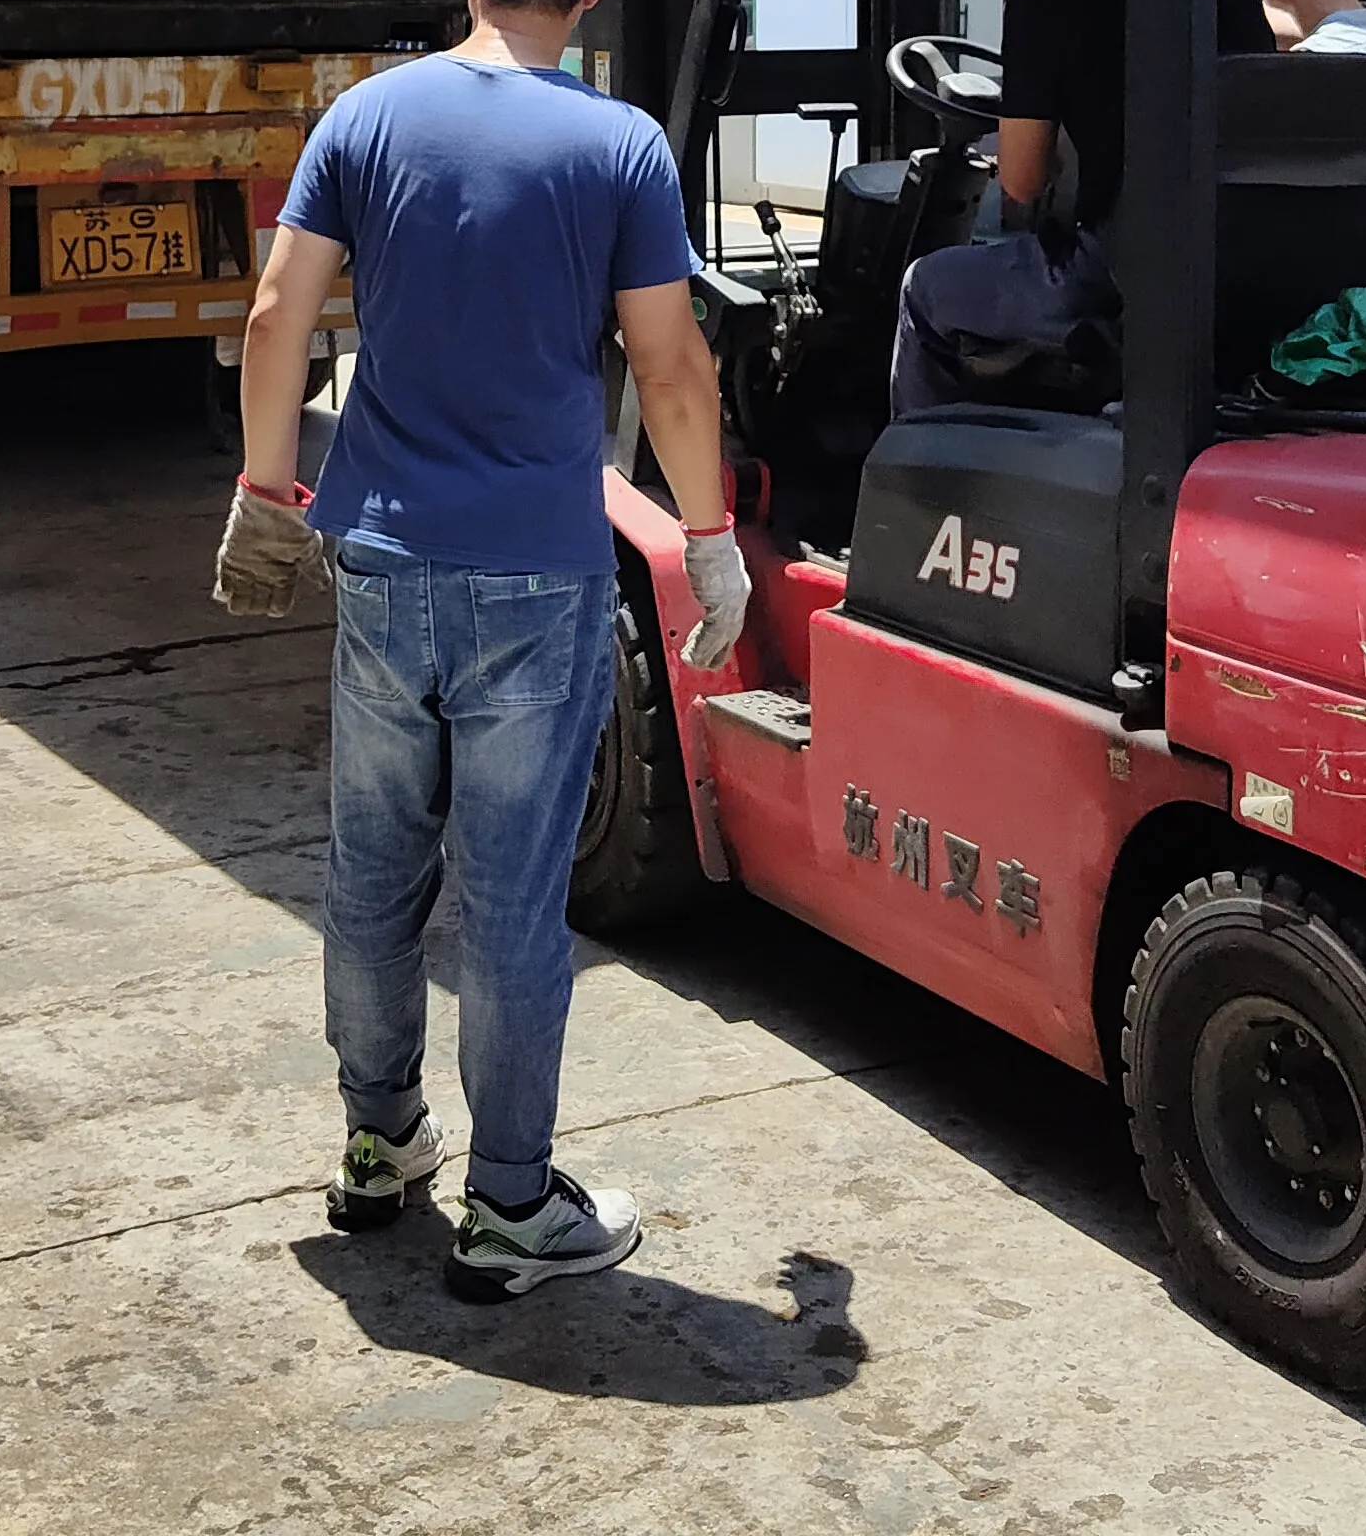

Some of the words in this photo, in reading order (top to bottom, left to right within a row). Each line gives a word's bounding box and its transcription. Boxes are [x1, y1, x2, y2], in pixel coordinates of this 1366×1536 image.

[59, 231, 185, 277] XD57挂
[917, 515, 1020, 599] A35
[842, 782, 1041, 938] 杭州叉车
